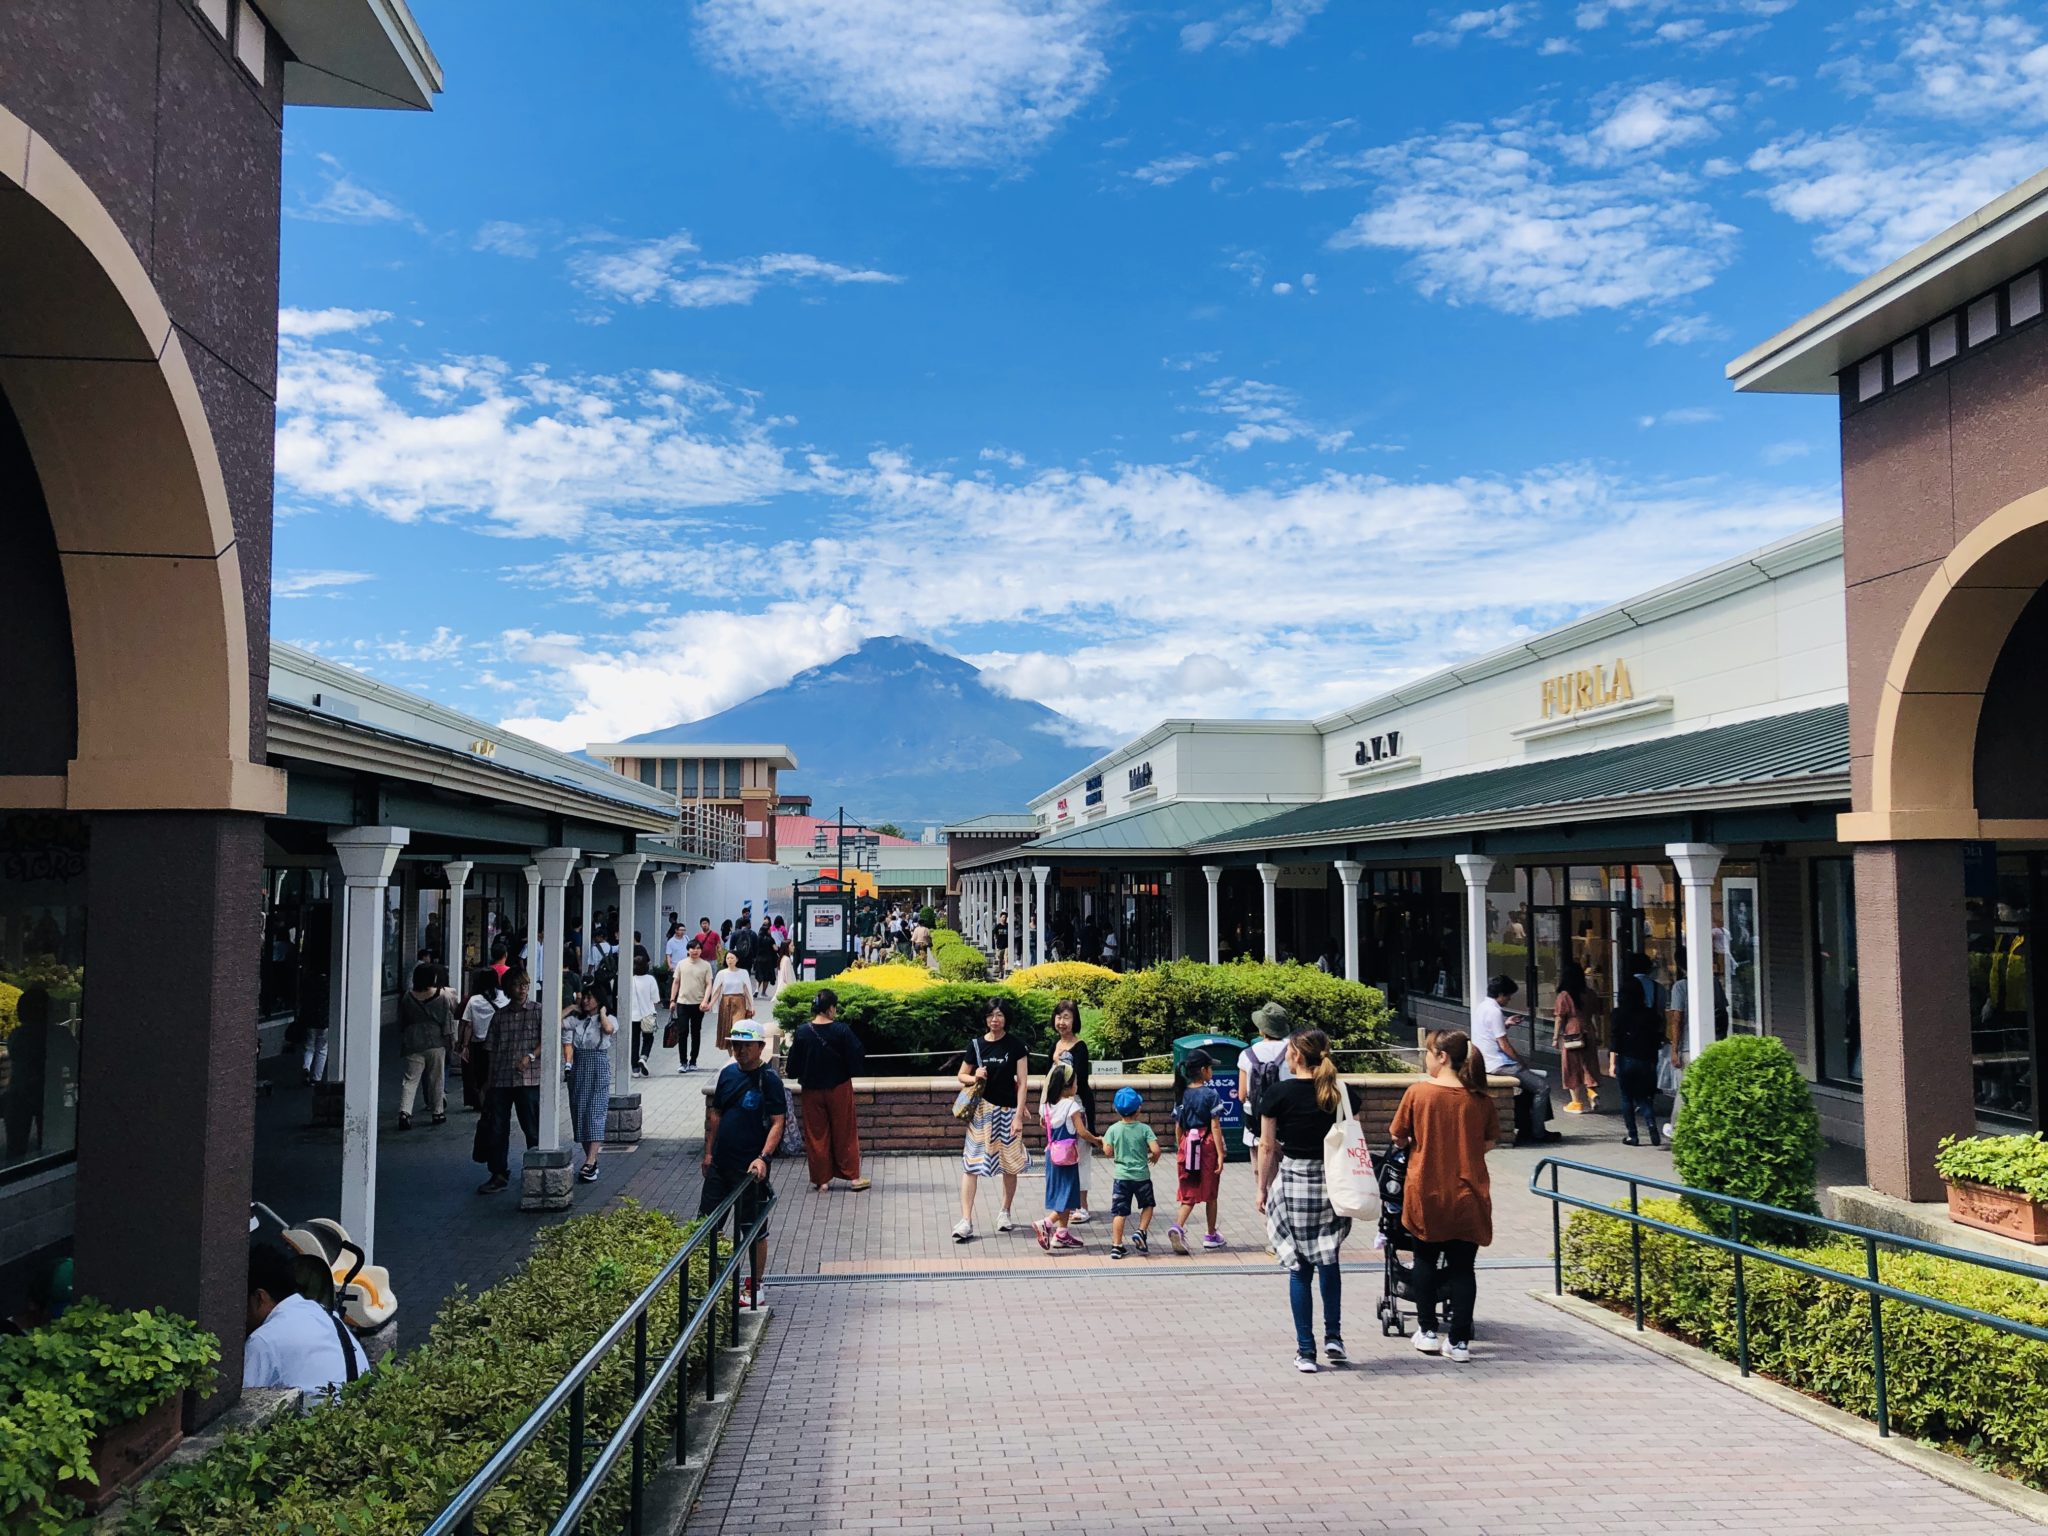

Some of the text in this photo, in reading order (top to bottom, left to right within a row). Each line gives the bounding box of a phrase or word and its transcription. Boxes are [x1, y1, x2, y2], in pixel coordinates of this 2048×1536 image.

[1541, 658, 1633, 718] FURLA
[1355, 731, 1400, 766] a.v.v
[1282, 866, 1321, 875] a.v.v
